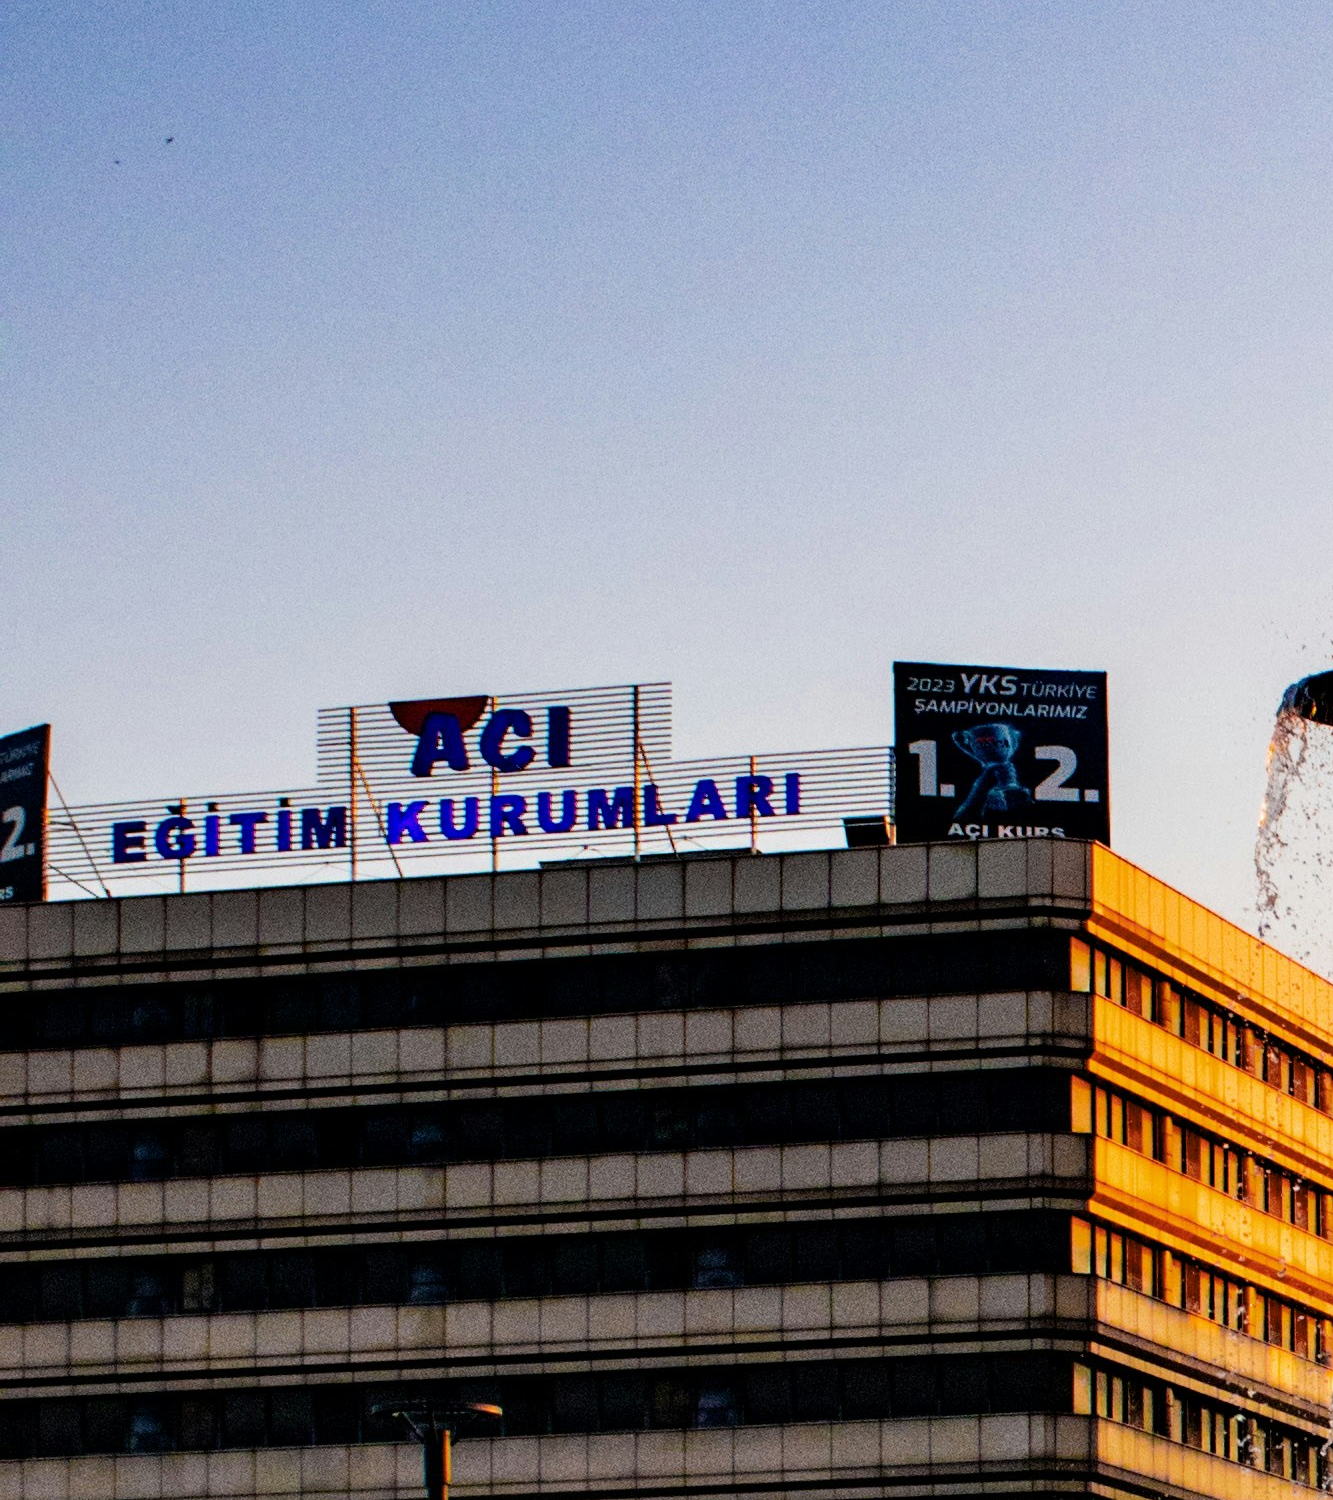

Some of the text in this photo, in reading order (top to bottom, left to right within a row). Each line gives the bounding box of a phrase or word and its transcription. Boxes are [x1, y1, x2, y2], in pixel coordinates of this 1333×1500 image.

[906, 673, 1098, 699] 2023 YKS TÜRKİYE
[914, 698, 1089, 719] ŞAMPİYONLARIMIZ
[908, 739, 1100, 803] 1. 2.
[113, 772, 801, 864] EĞİTİM KURUMLARI
[947, 823, 1067, 840] AÇI KURS
